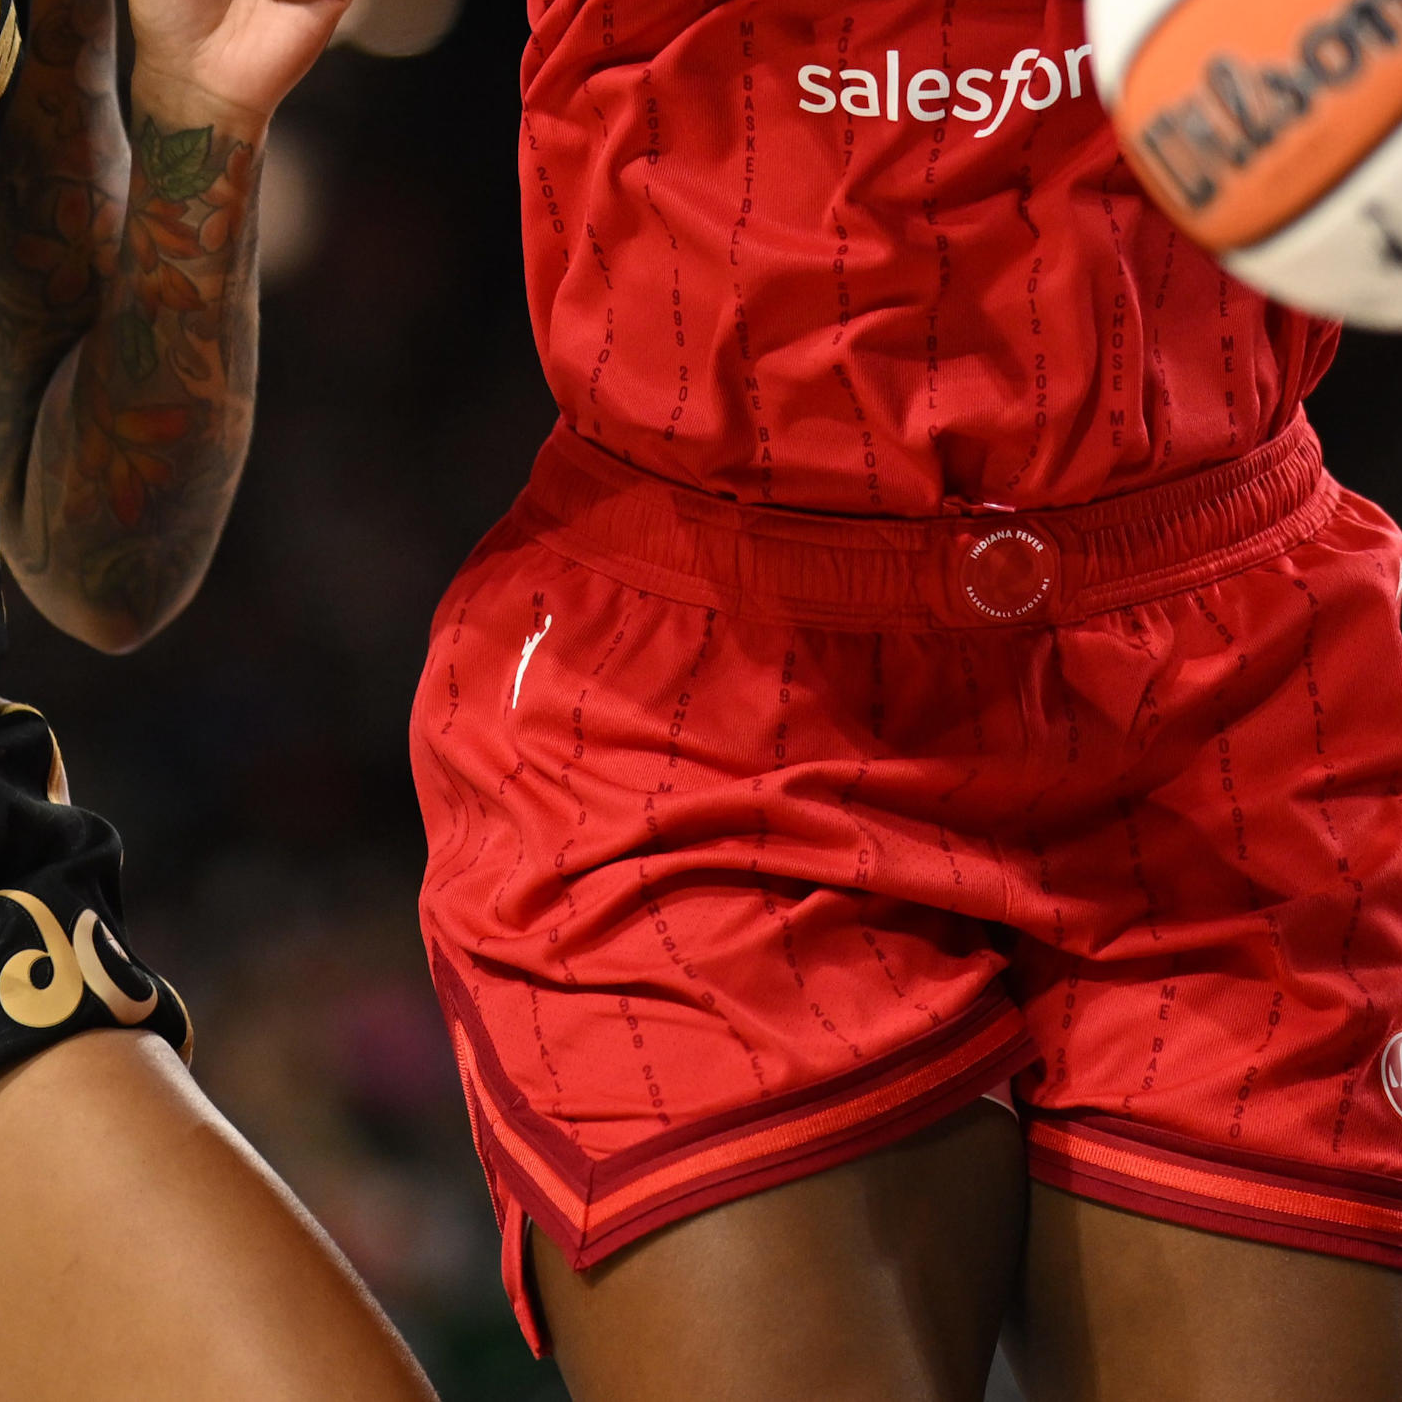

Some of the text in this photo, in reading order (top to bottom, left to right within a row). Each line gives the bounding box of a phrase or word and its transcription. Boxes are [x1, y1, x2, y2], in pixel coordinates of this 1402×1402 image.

[797, 43, 1093, 139] salesfor
[969, 529, 1045, 560] INDIANA FEVER
[965, 577, 1051, 619] BASKETBALL CHOSE ME
